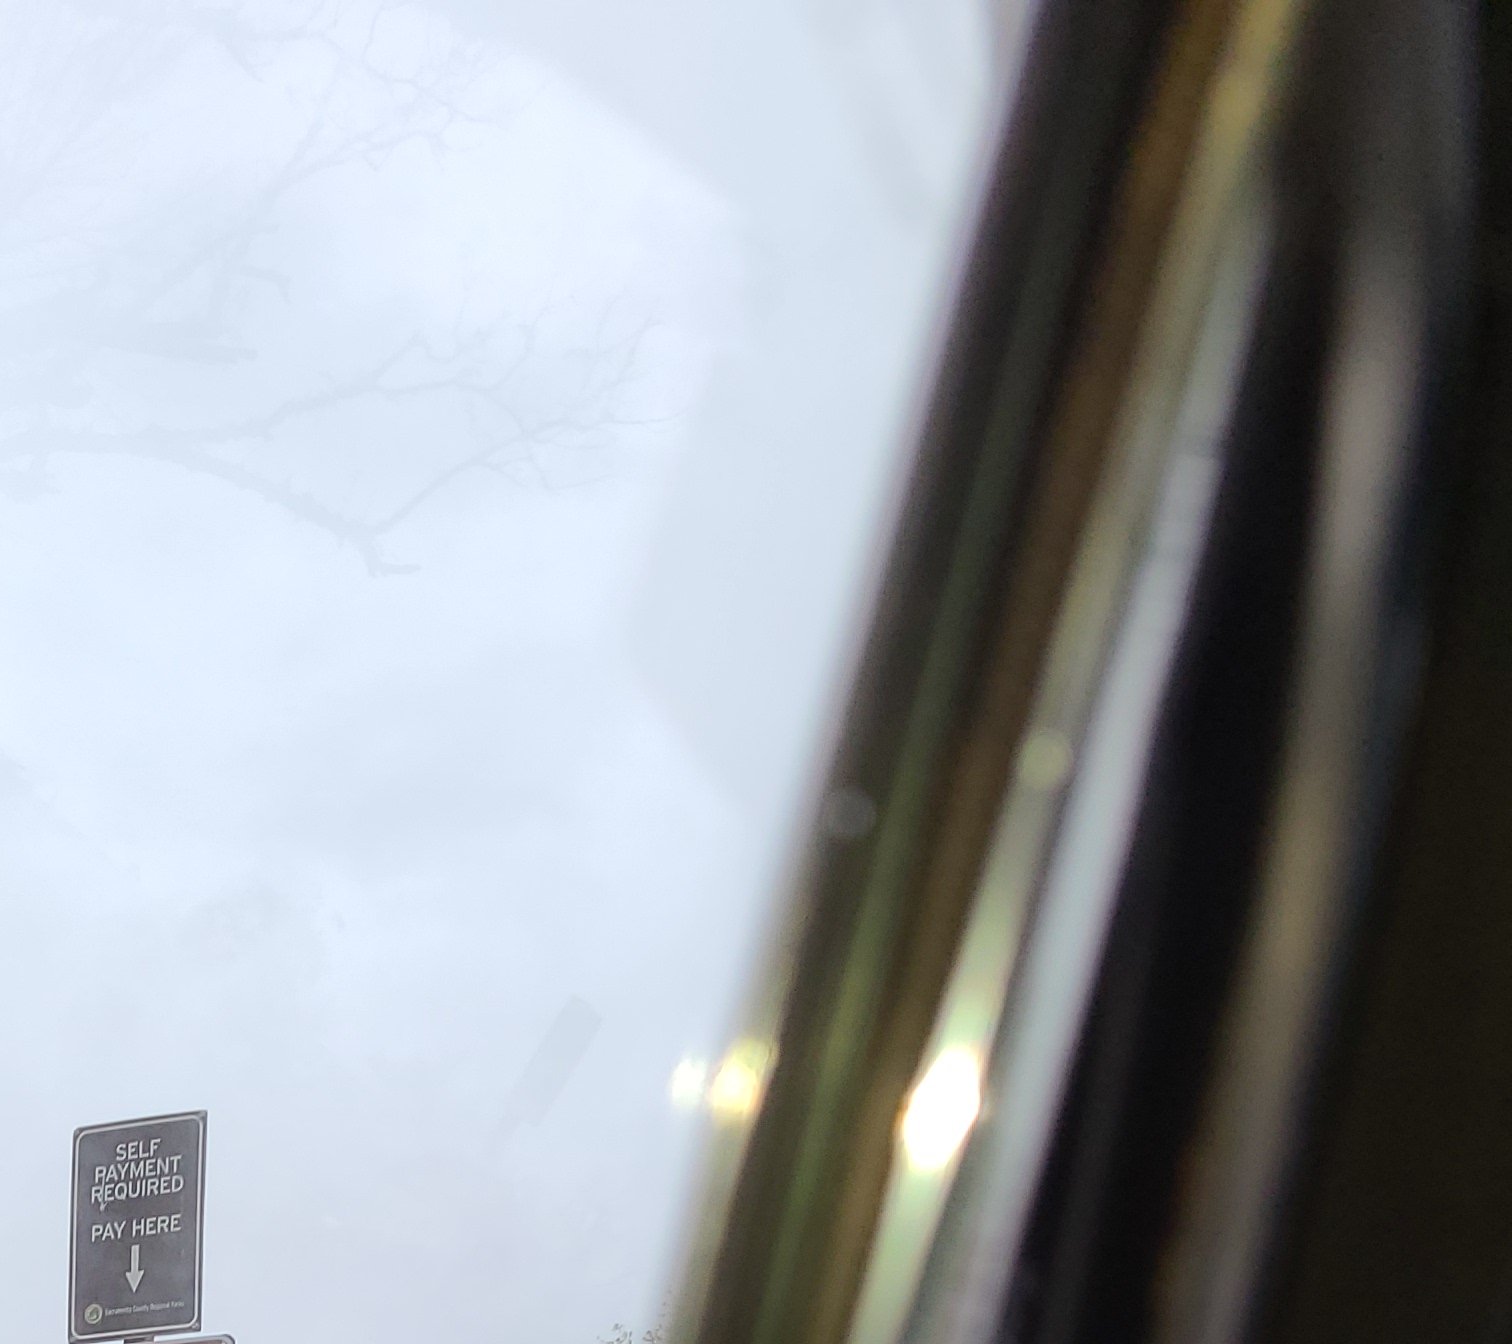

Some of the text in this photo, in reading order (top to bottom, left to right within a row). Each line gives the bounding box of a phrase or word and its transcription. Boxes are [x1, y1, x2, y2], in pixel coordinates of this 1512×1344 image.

[115, 1138, 161, 1161] SELF
[94, 1155, 182, 1184] PAYMENT
[90, 1175, 184, 1204] REQUIRED
[91, 1214, 182, 1242] PAY HERE
